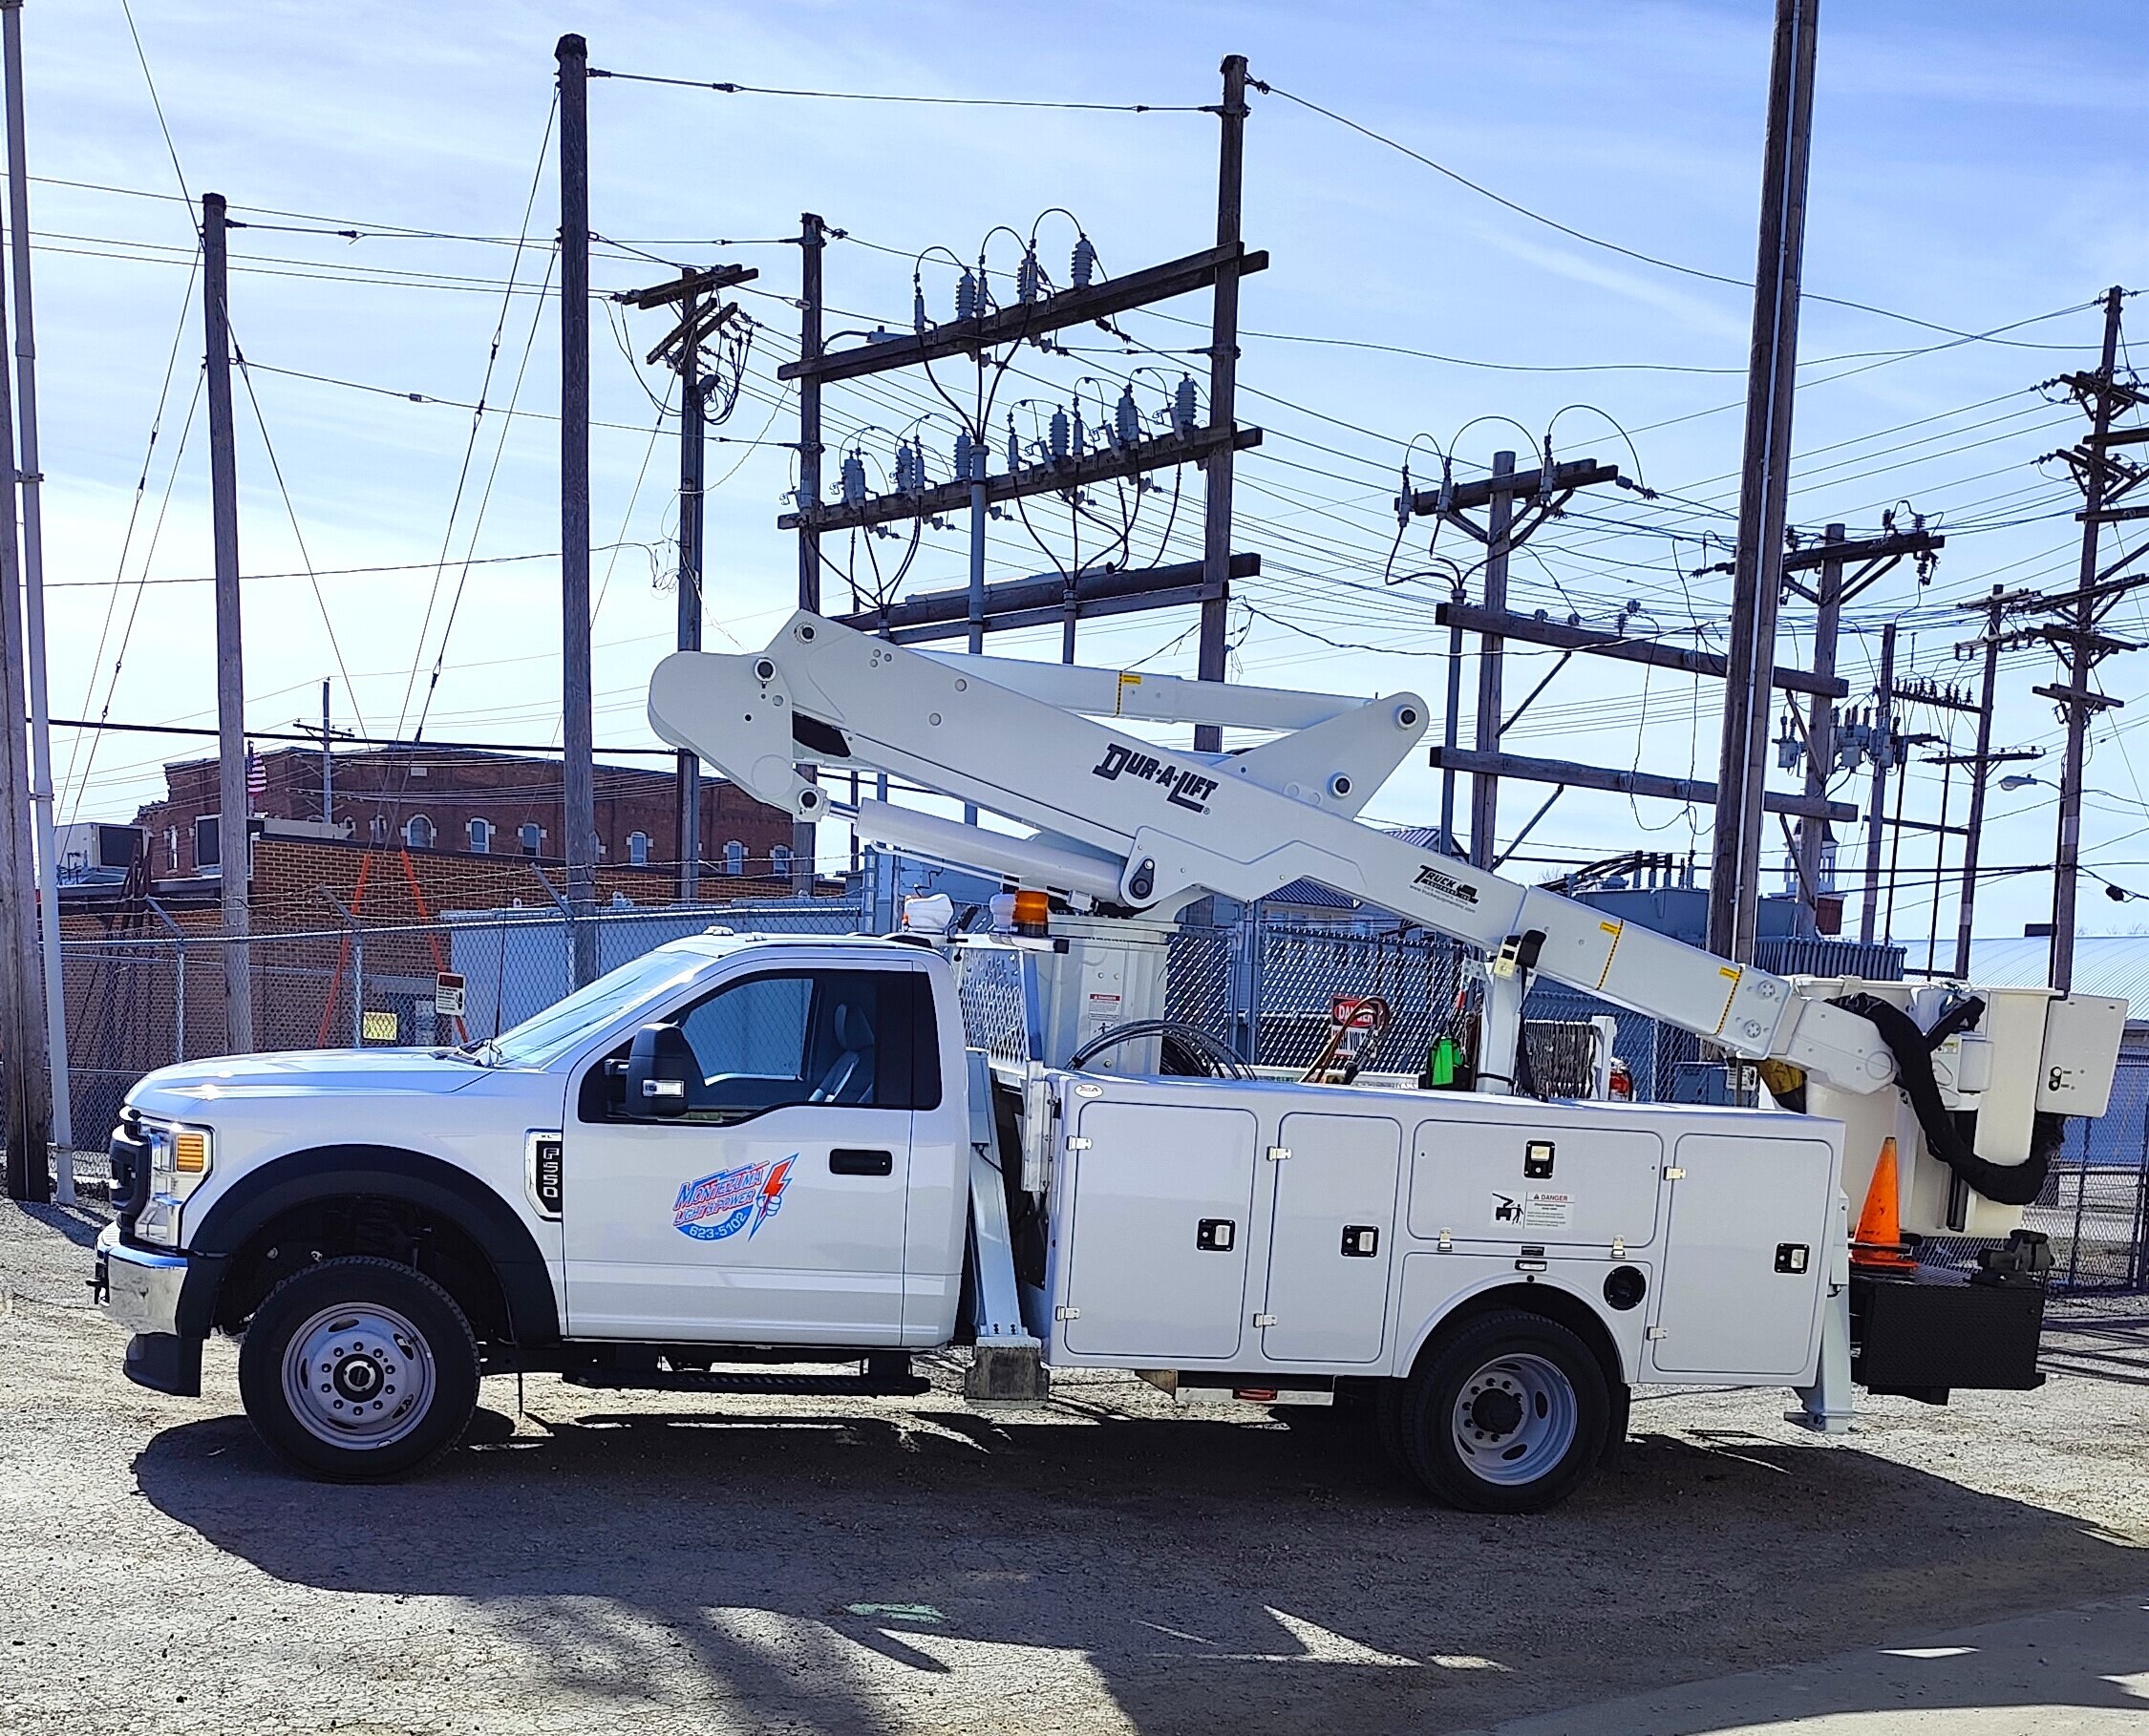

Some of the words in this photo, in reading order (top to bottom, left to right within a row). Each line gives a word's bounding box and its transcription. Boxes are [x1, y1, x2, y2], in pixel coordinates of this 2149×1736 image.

[1413, 864, 1458, 889] TRUCK
[672, 1166, 765, 1211] MONTEZUMA
[672, 1204, 708, 1227] LIGHT
[716, 1188, 755, 1211] POWER
[689, 1211, 747, 1238] 623-5102
